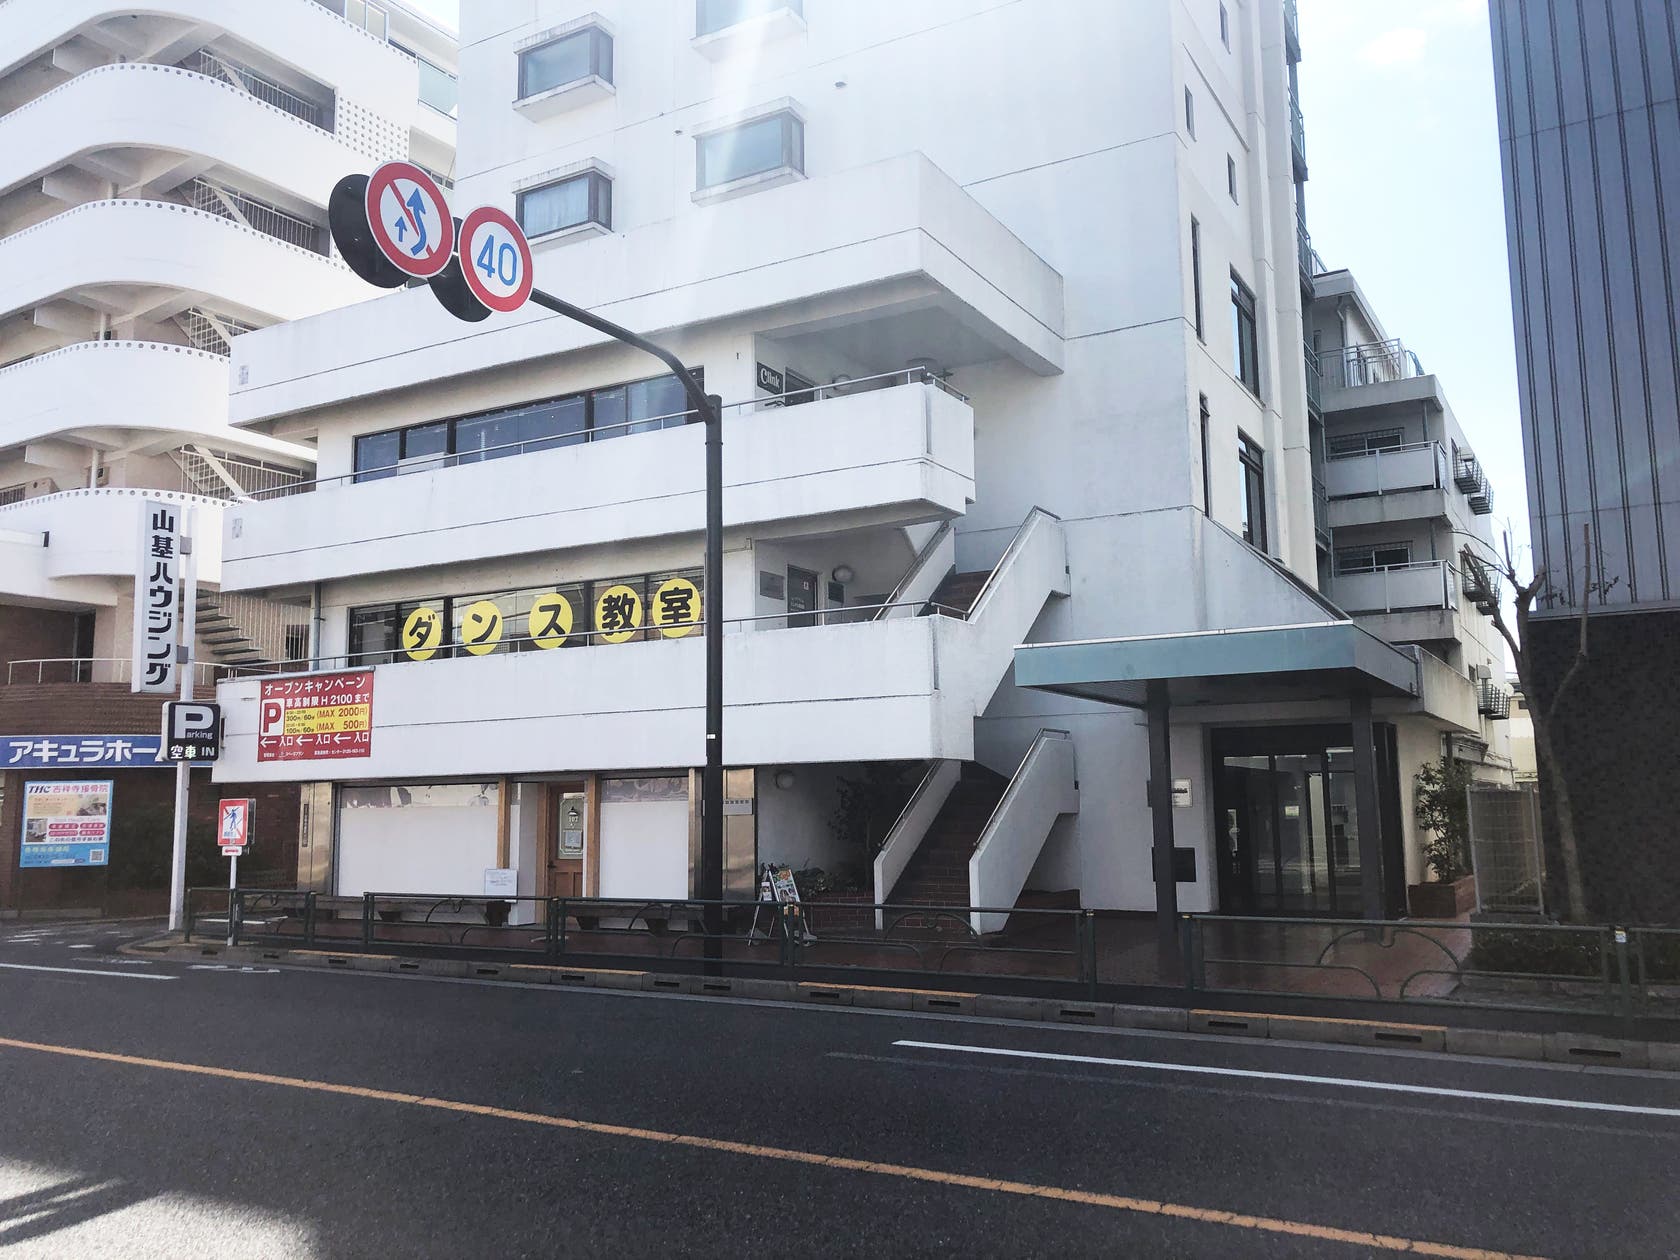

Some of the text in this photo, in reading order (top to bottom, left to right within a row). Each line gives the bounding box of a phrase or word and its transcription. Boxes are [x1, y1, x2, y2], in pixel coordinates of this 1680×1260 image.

[477, 234, 517, 286] 40
[145, 509, 174, 685] 山基ハウジング
[408, 586, 692, 653] ダンス教室
[264, 677, 365, 696] オープンキャンペーン
[321, 697, 328, 705] H
[331, 694, 352, 705] 2100
[355, 693, 370, 703] まで
[263, 702, 282, 733] P
[280, 732, 369, 747] 入口 入口 入口
[9, 739, 164, 763] アキュラホー
[170, 744, 215, 759] 空車 IN
[28, 785, 51, 794] THC
